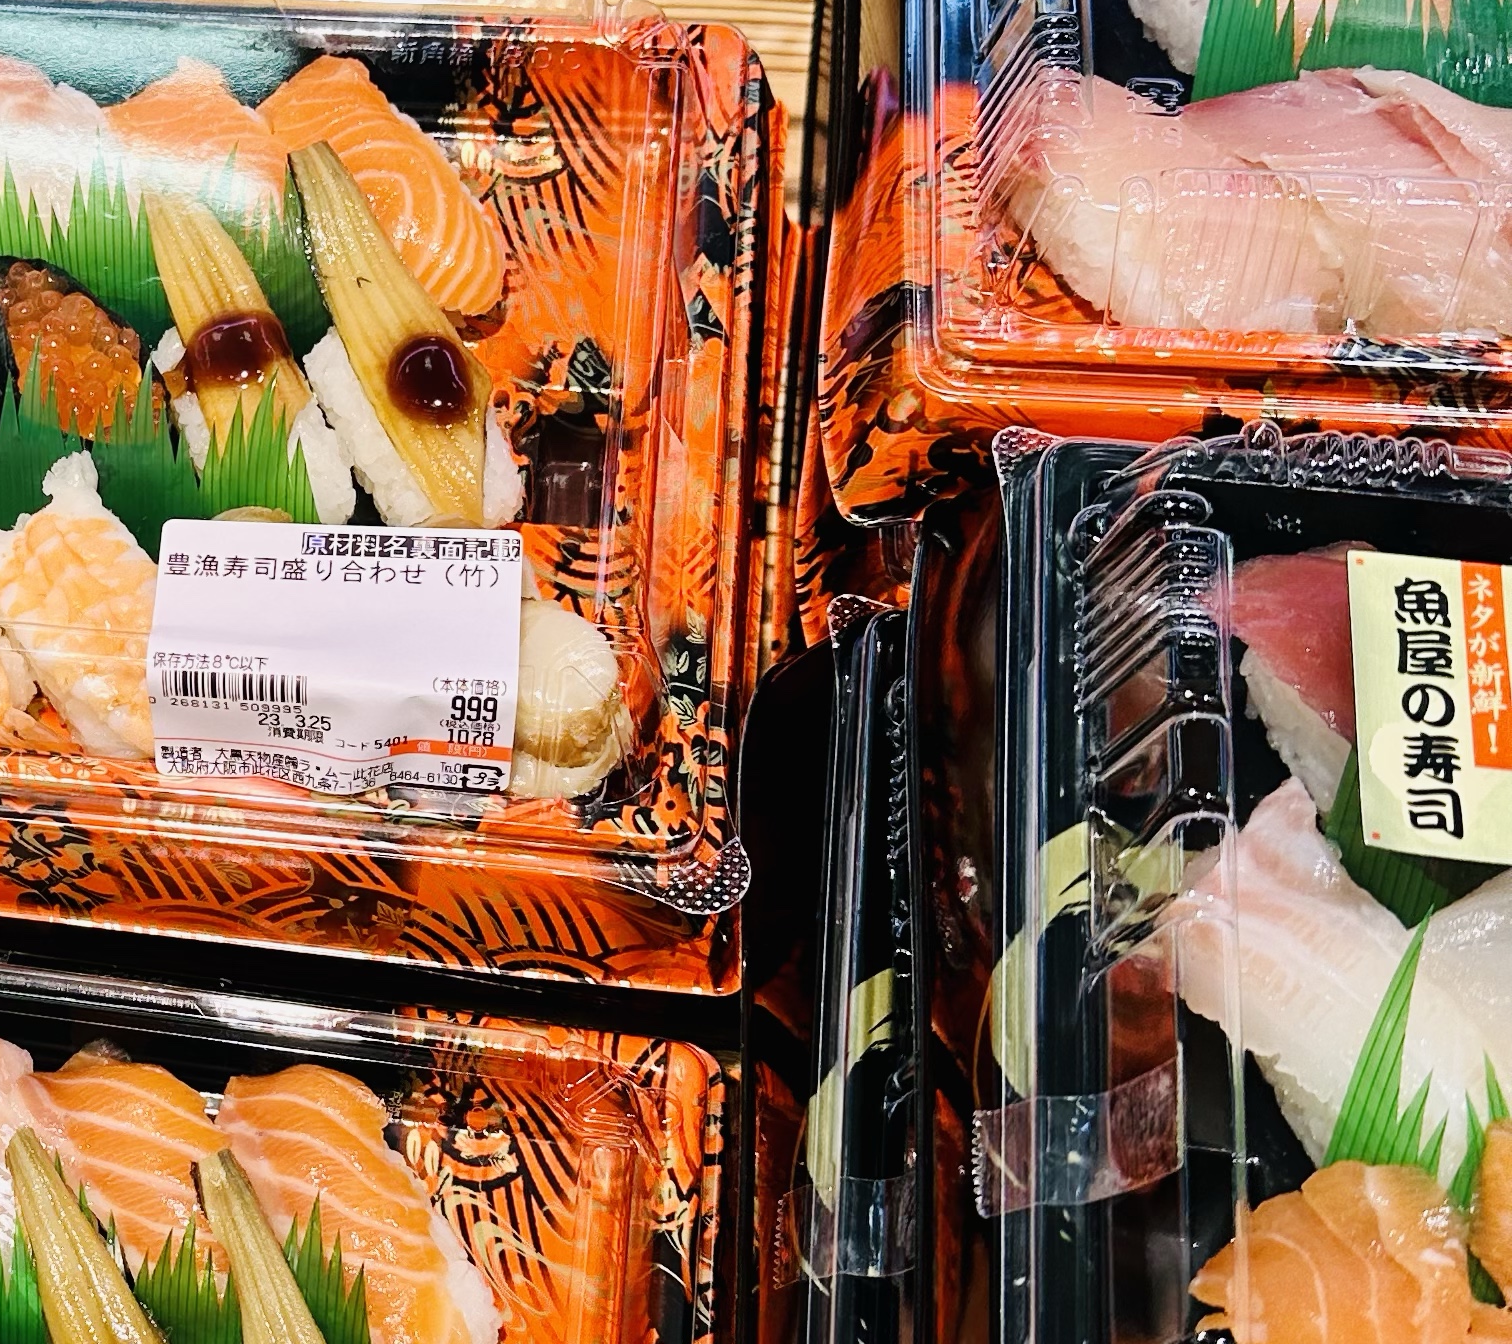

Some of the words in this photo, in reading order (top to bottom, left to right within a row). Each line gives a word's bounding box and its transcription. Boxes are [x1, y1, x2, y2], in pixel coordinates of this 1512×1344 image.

[300, 532, 521, 562] 原材料名裏面記載
[1467, 573, 1507, 754] ネタが新鮮！
[451, 696, 498, 723] 999
[1394, 577, 1464, 839] 魚屋の寿司
[268, 727, 324, 744] 消費期限
[447, 729, 494, 747] 1078
[161, 746, 202, 761] 製造者
[390, 771, 458, 786] 6464-6130
